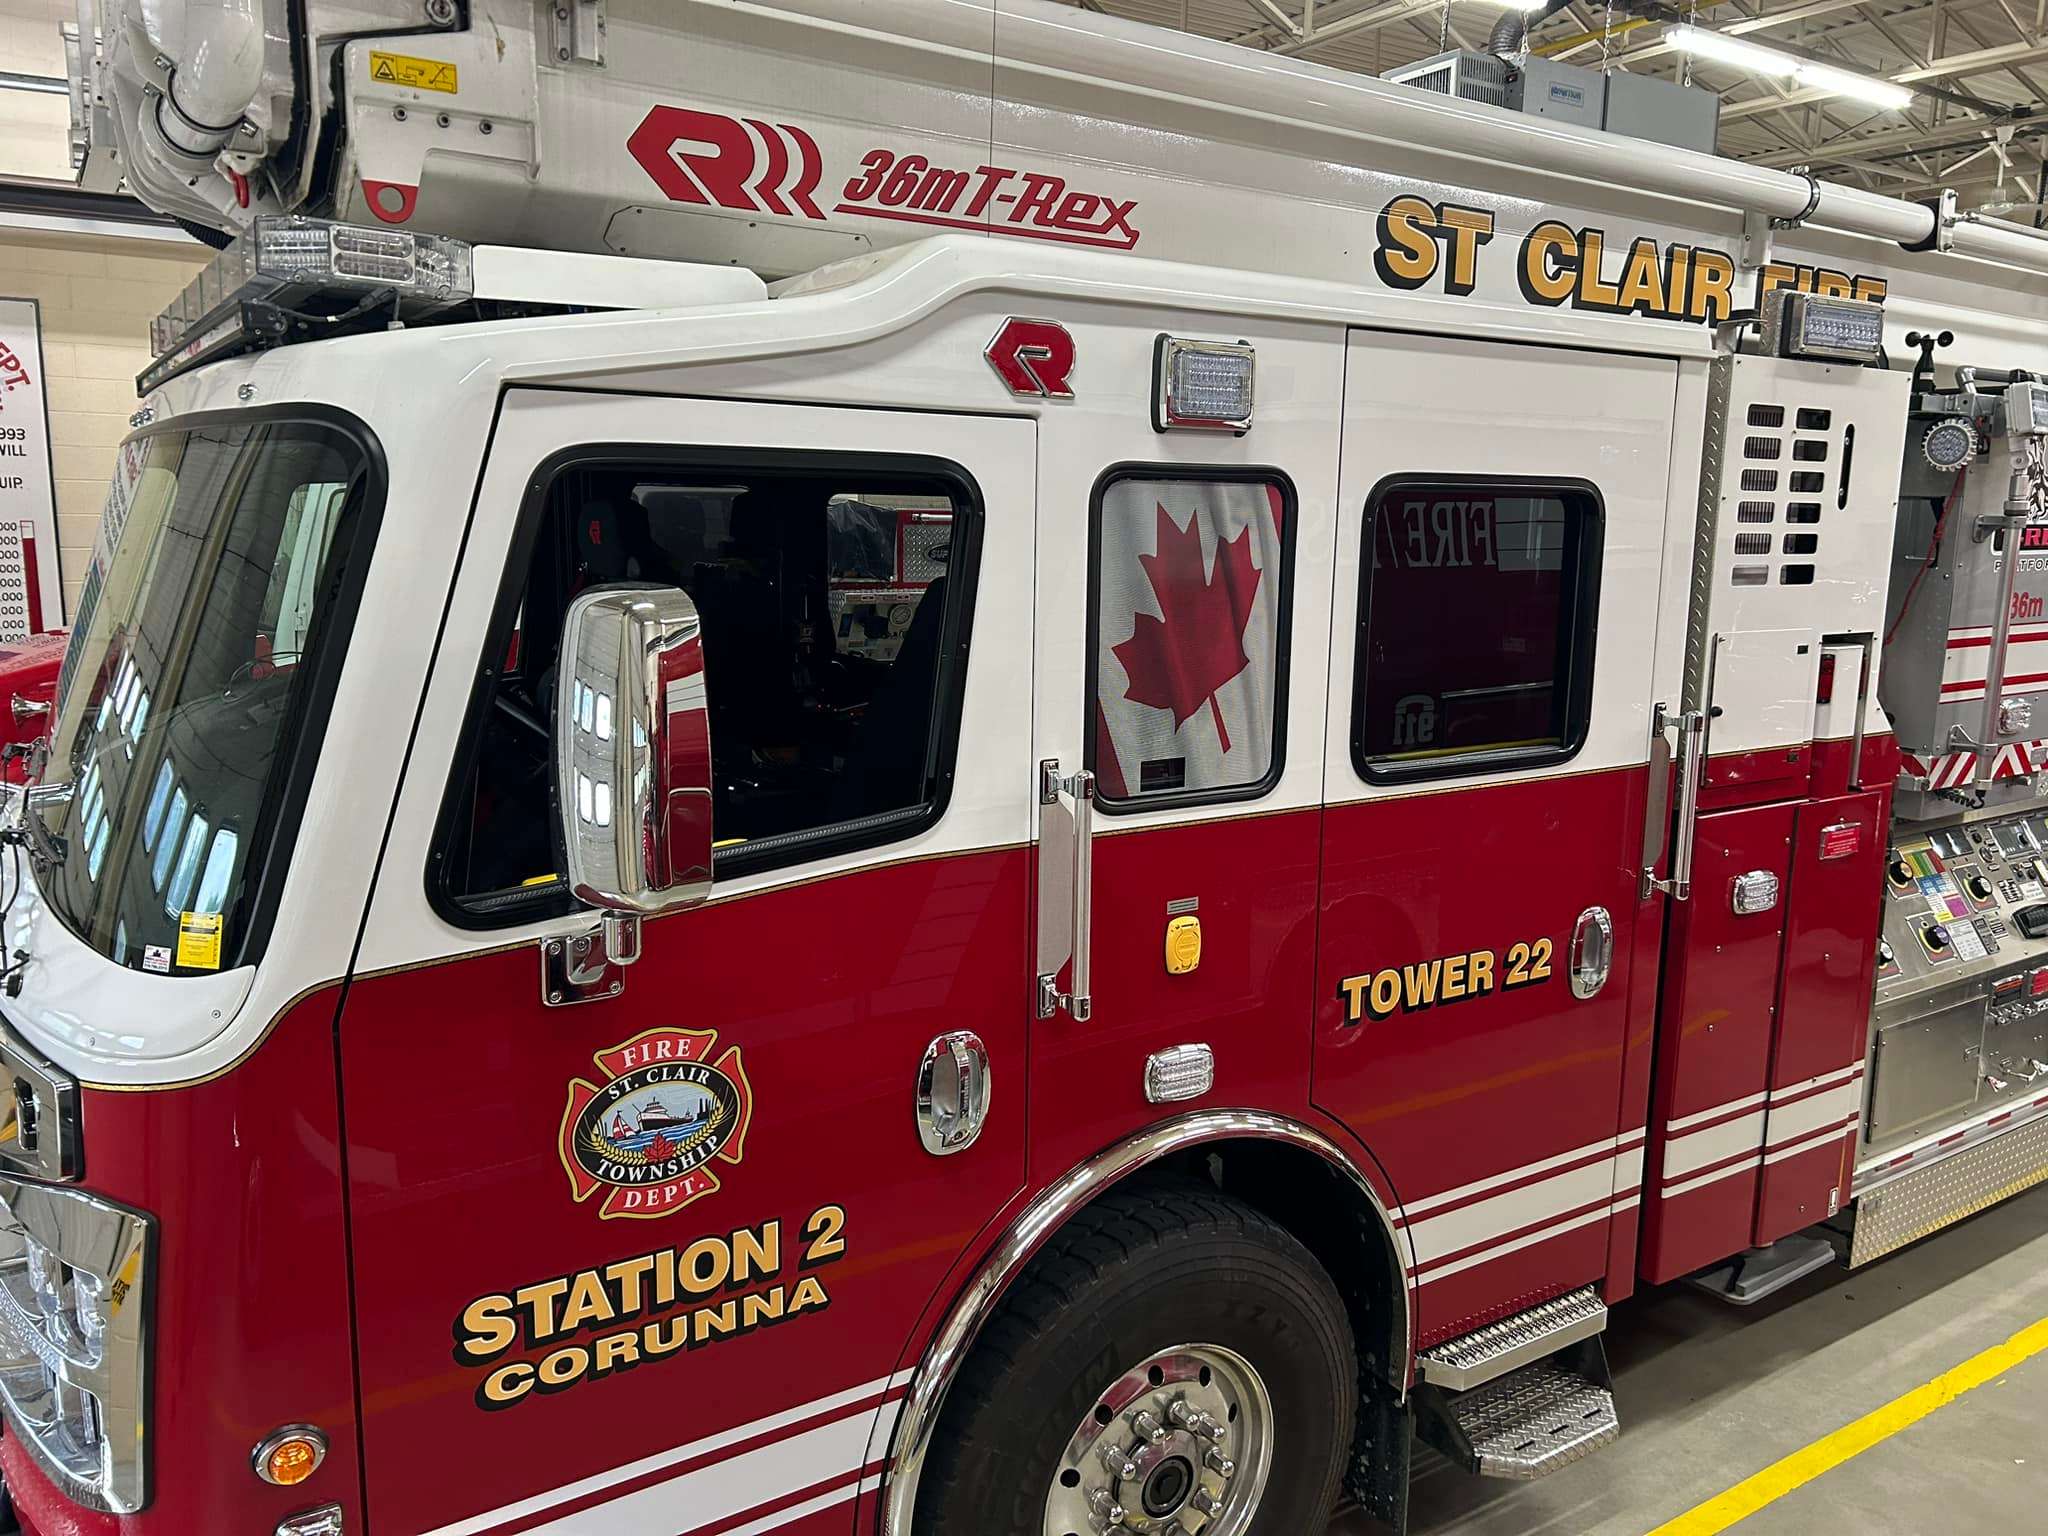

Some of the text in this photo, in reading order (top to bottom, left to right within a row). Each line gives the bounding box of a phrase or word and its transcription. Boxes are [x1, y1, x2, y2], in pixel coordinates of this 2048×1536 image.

[1374, 195, 1495, 295] ST
[1517, 219, 1735, 328] CLAIR
[1337, 937, 1553, 1027] TOWER 22
[608, 1066, 711, 1100] ST. CLAIR
[622, 1038, 691, 1069] FIRE
[596, 1135, 718, 1182] TOWNSHIP
[623, 1177, 705, 1209] DEPT.
[453, 1203, 848, 1367] STATION 2
[475, 1277, 832, 1411] CORUNNA
